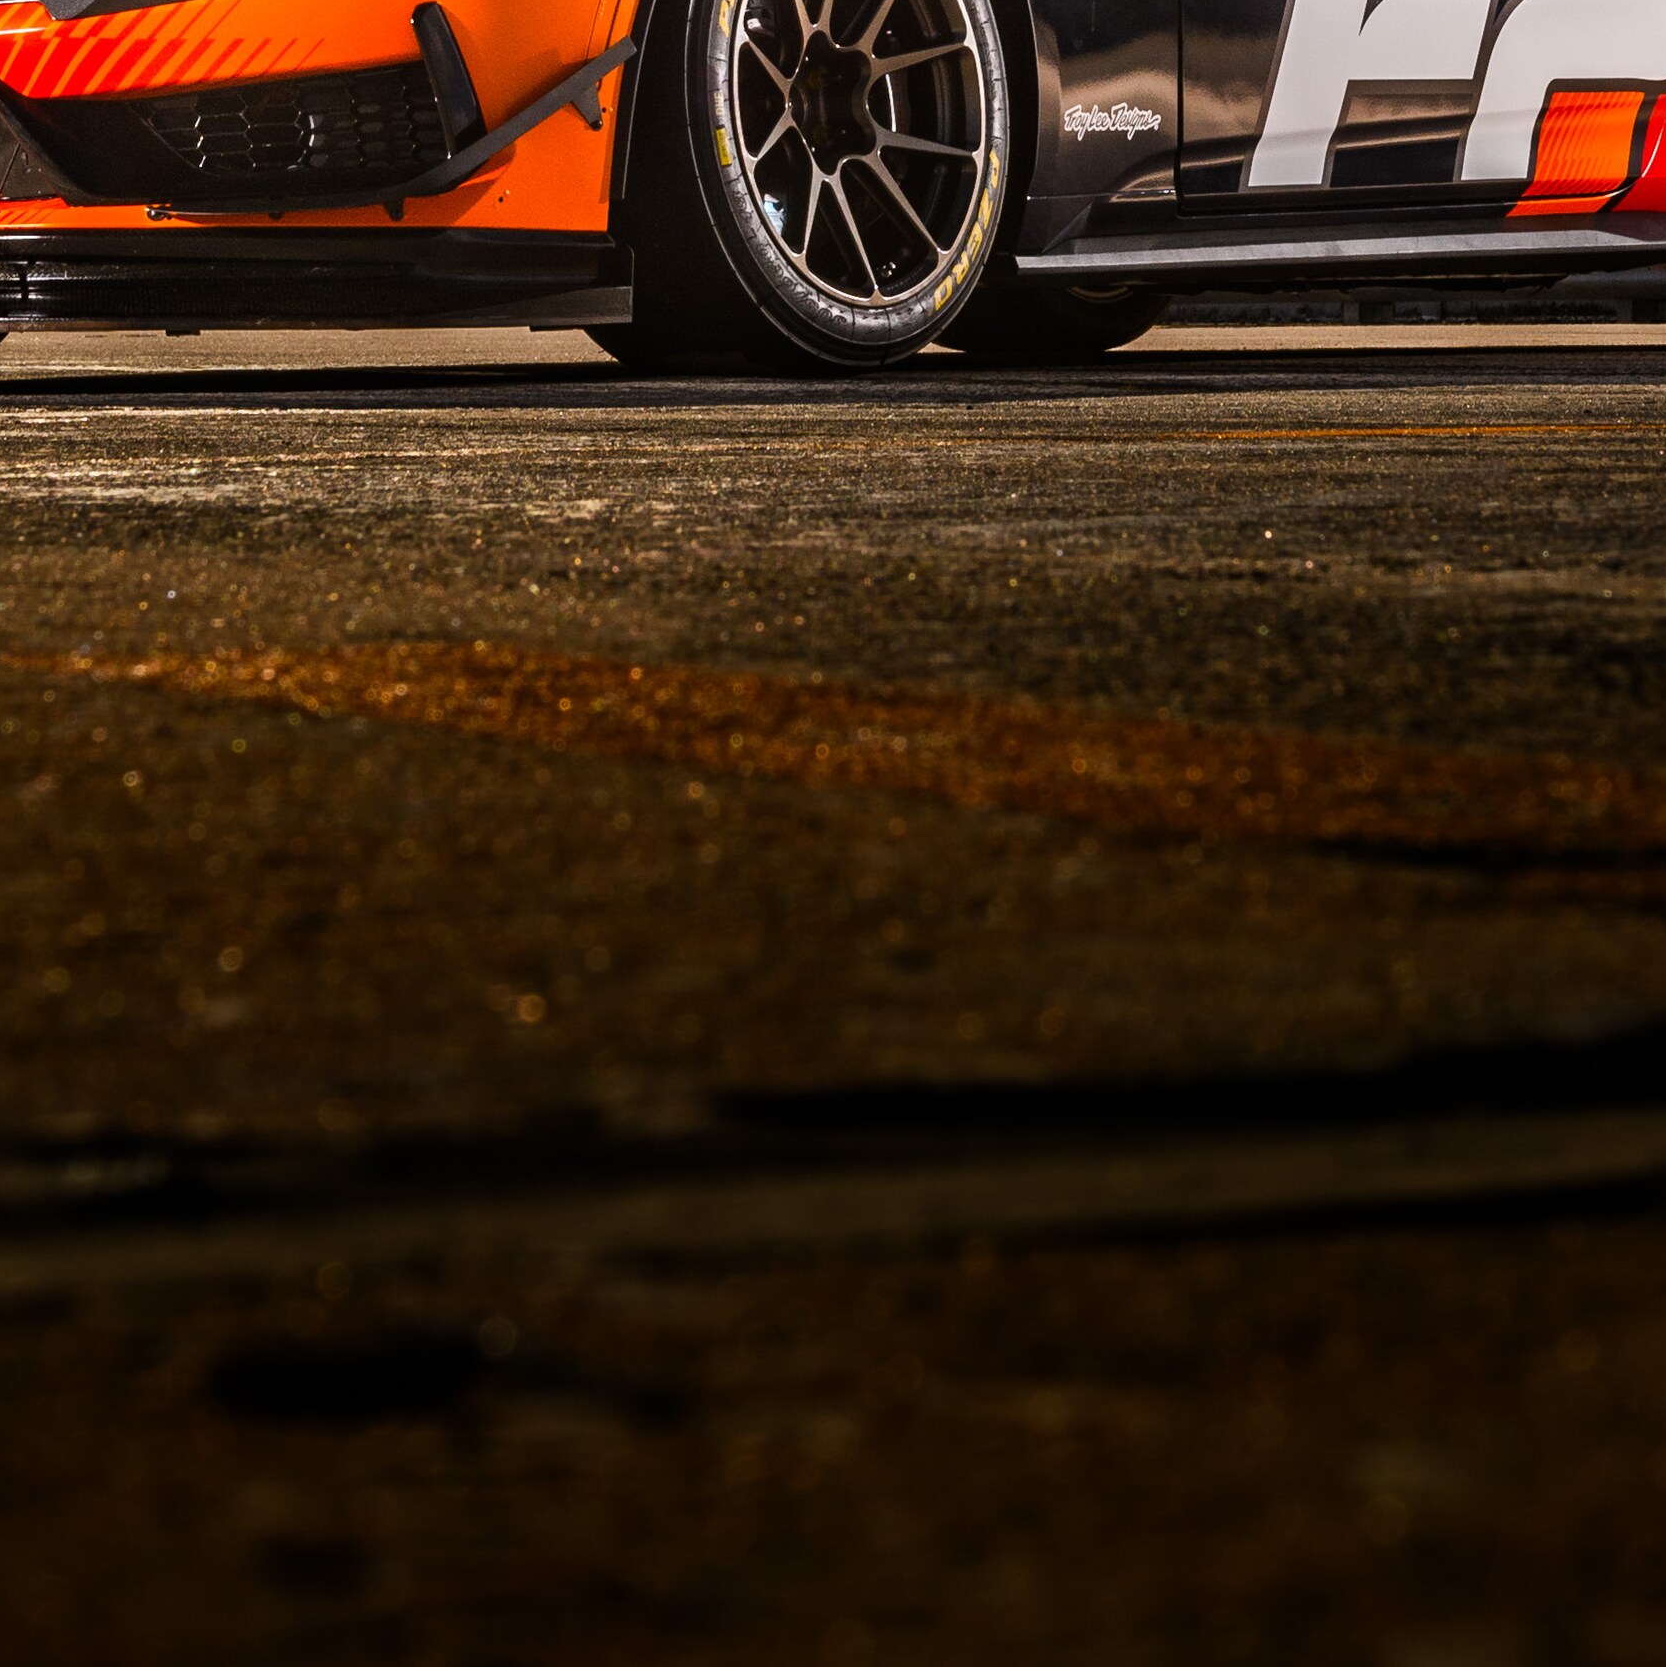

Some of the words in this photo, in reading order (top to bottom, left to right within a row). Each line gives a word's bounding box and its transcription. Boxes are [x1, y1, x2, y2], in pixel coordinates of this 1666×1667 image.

[1064, 104, 1088, 141] Troy
[1087, 104, 1110, 131] Lee
[1110, 102, 1161, 140] Designs
[989, 149, 1000, 189] P
[934, 188, 994, 311] ZERO
